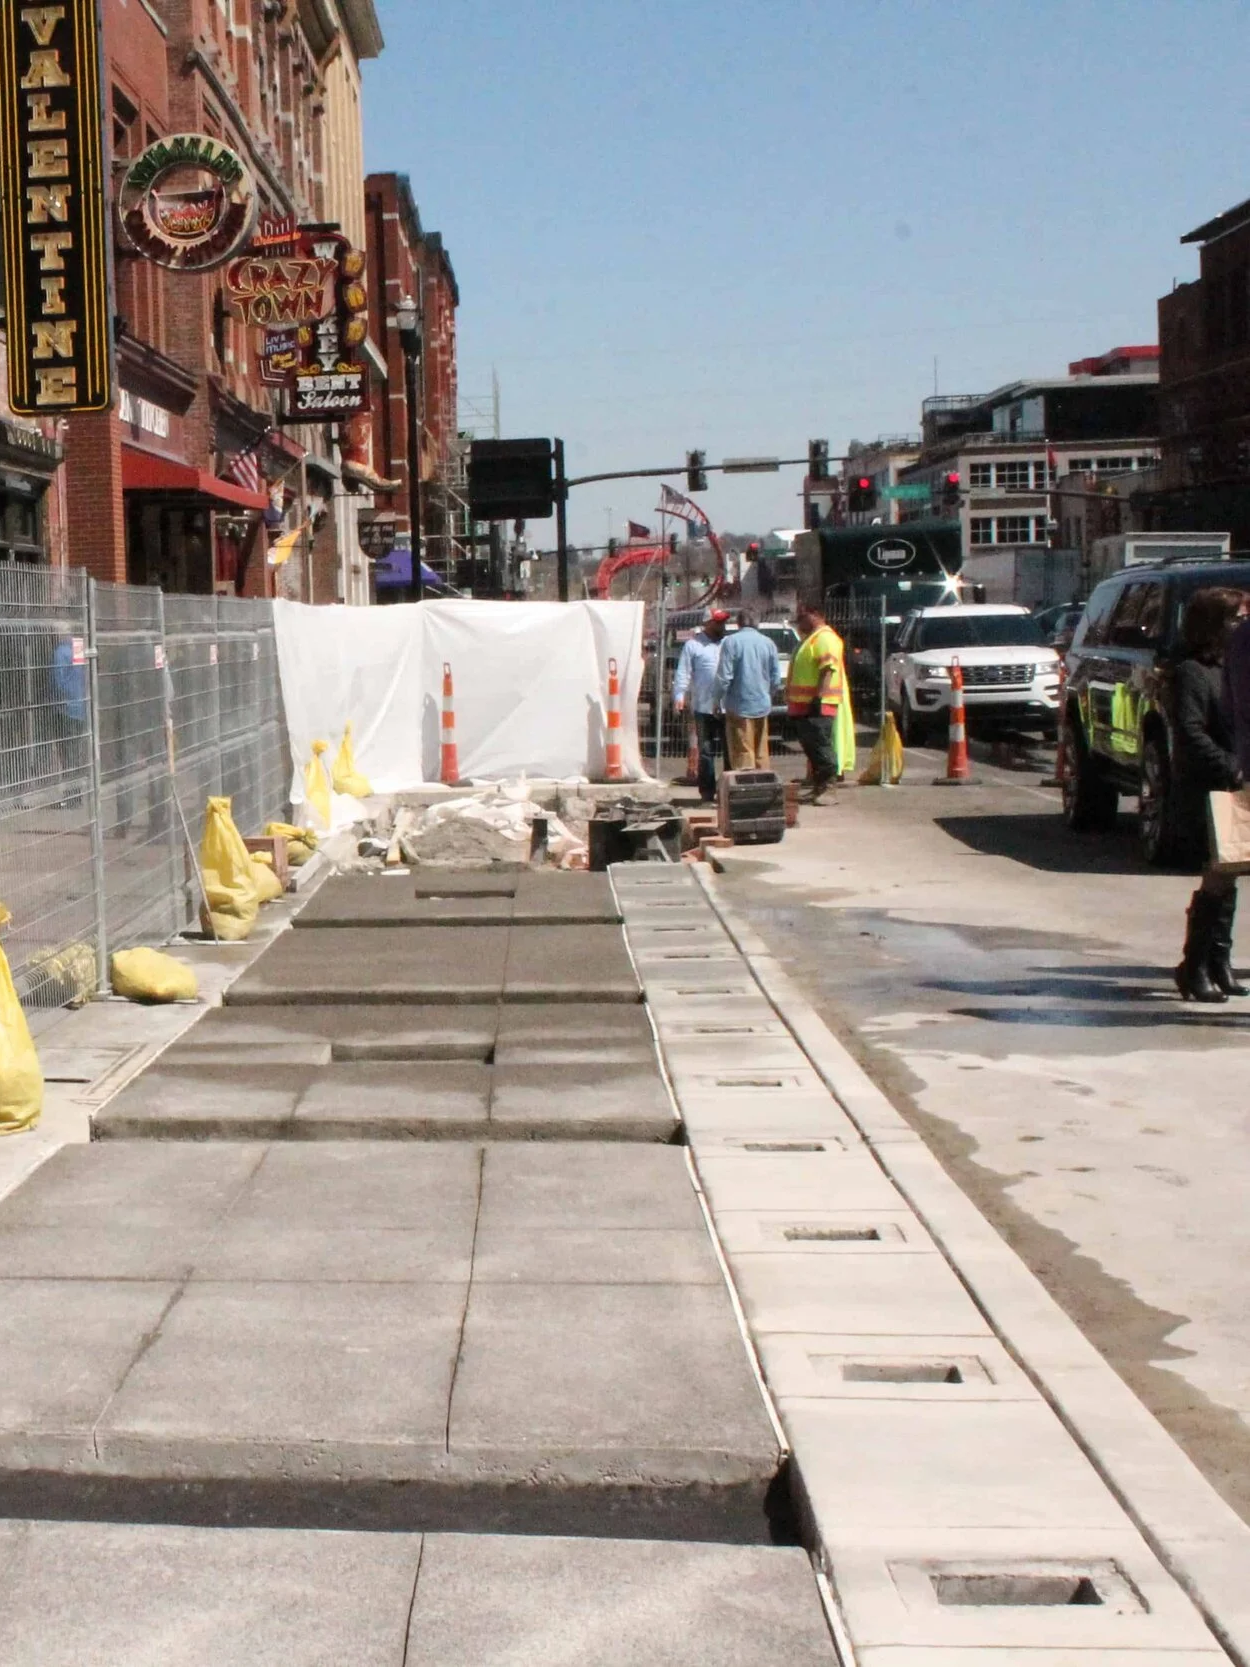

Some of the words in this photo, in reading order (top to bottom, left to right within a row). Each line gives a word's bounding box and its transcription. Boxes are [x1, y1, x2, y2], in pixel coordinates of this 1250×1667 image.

[20, 6, 77, 406] VALENTINE
[227, 256, 338, 294] CRAZY
[231, 288, 324, 326] TOWN
[296, 373, 362, 392] BENT
[297, 391, 362, 409] Saloon
